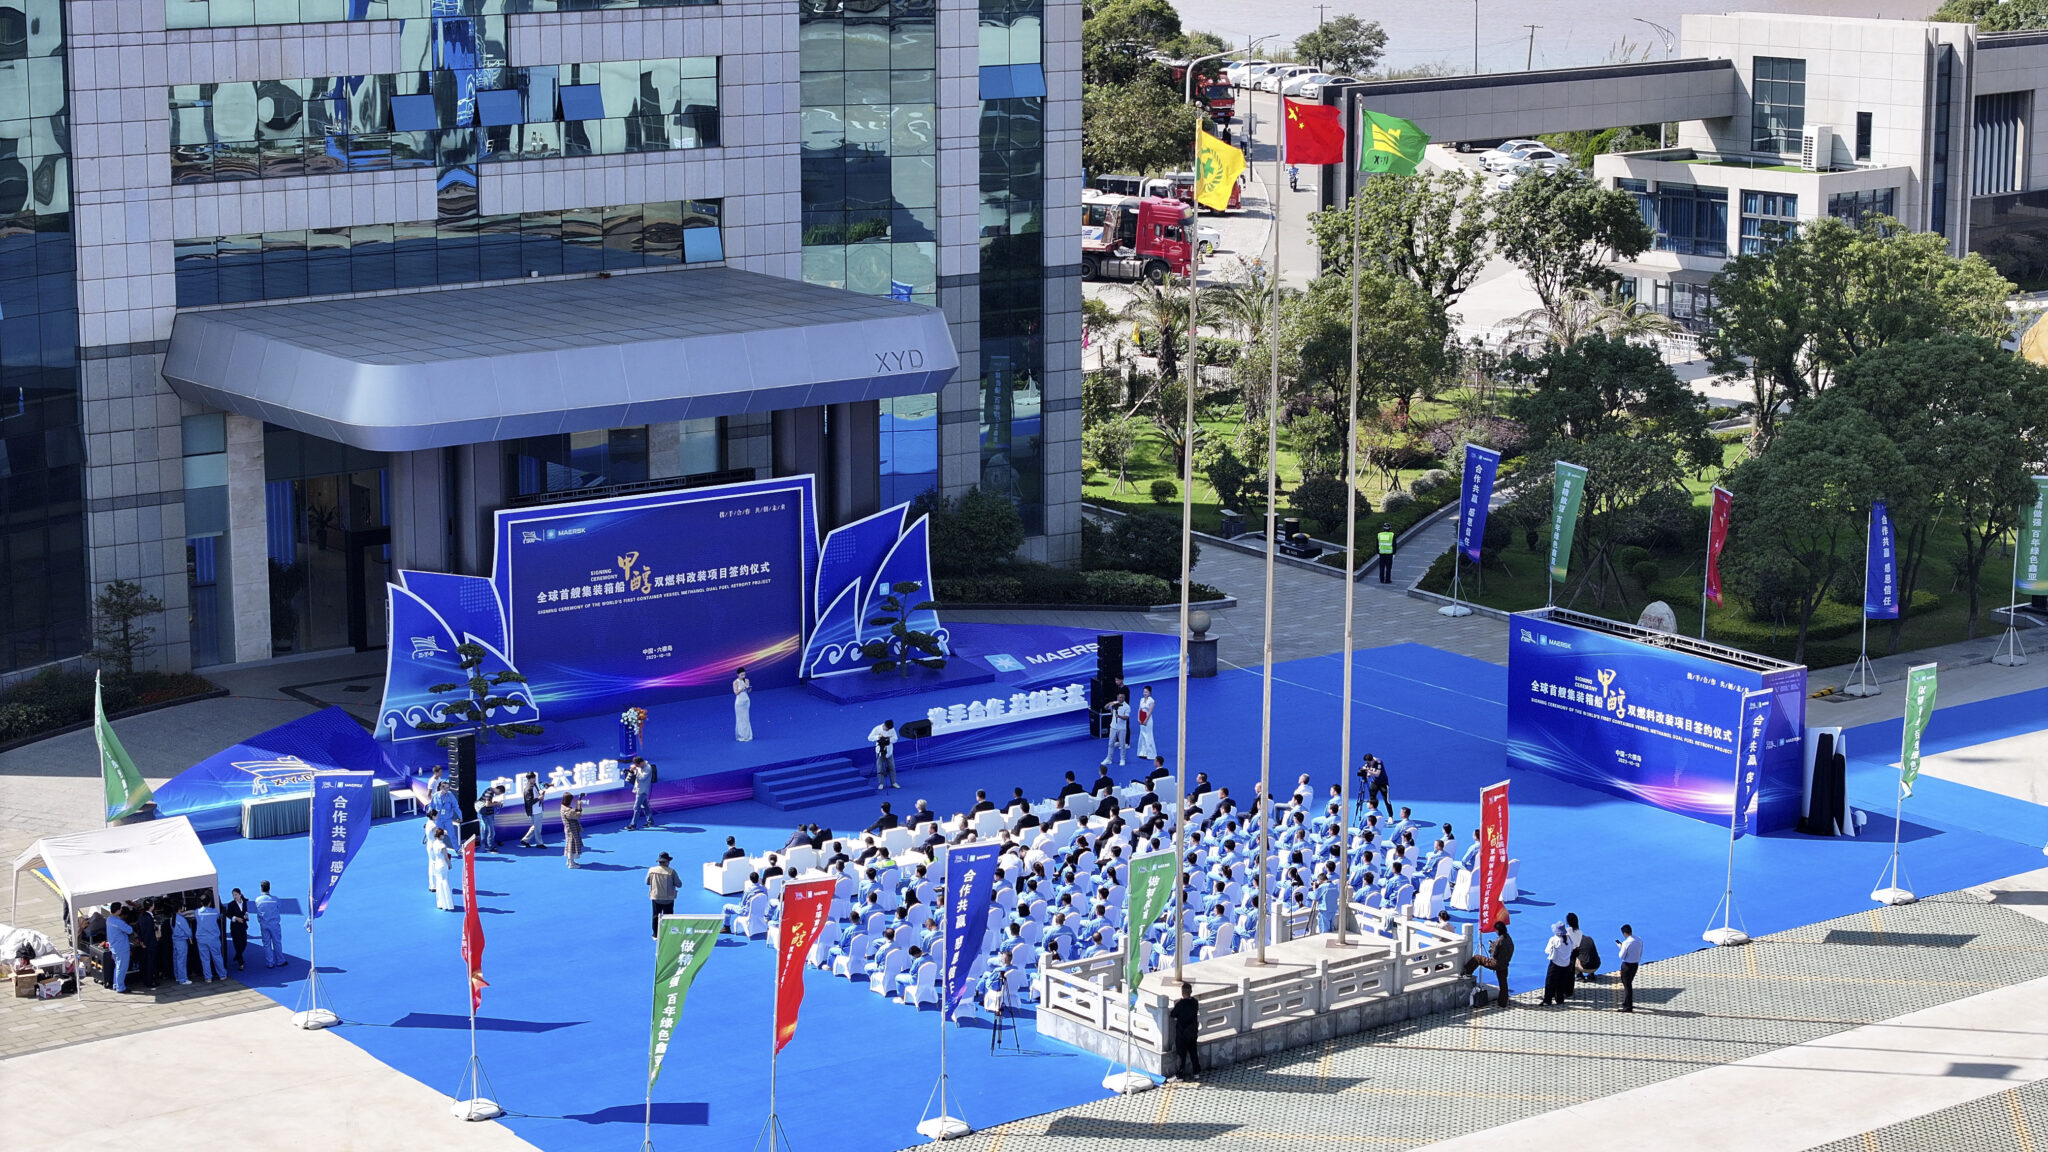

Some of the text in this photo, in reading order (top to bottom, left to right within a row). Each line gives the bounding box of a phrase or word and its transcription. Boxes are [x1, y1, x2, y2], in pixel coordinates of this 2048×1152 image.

[875, 350, 924, 372] XYD
[558, 528, 586, 536] MAERSK
[537, 581, 625, 604] 全球首艘集装箱船
[654, 561, 771, 588] 双燃料改装项目签约仪式
[590, 568, 612, 576] SIGNING
[590, 574, 618, 582] CEREMONY
[558, 603, 583, 612] CEREMONY
[1025, 643, 1099, 664] MAERS
[1530, 680, 1604, 708] 全球首艘集装箱船
[1627, 704, 1733, 743] 双燃料改装项目签约仪式
[331, 795, 349, 853] 合作共赢
[954, 869, 977, 930] 合作共赢
